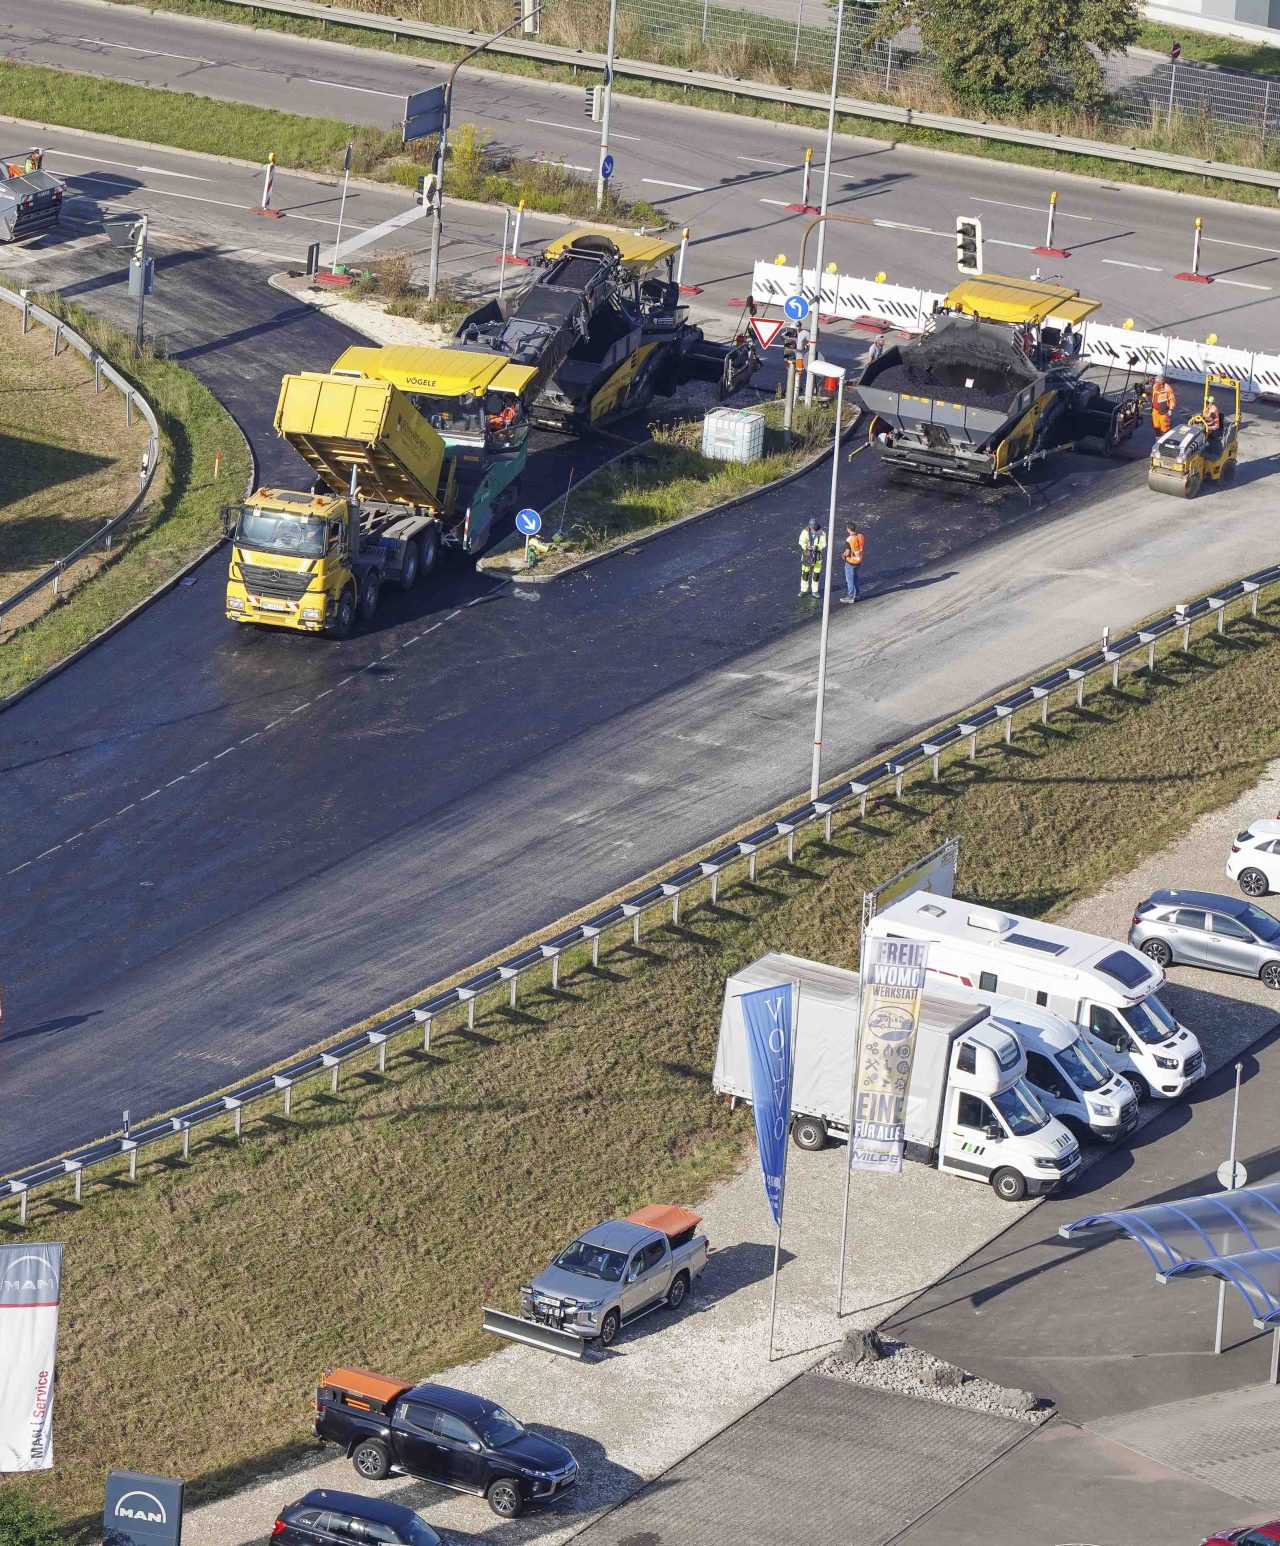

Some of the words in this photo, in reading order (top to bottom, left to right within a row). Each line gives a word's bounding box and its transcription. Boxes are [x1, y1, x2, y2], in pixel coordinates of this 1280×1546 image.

[406, 376, 436, 387] VÖGELE
[852, 1150, 899, 1163] MILDE
[3, 1279, 54, 1291] MAN
[33, 1370, 49, 1419] Service
[30, 1428, 43, 1459] MAN
[120, 1507, 161, 1523] MAN
